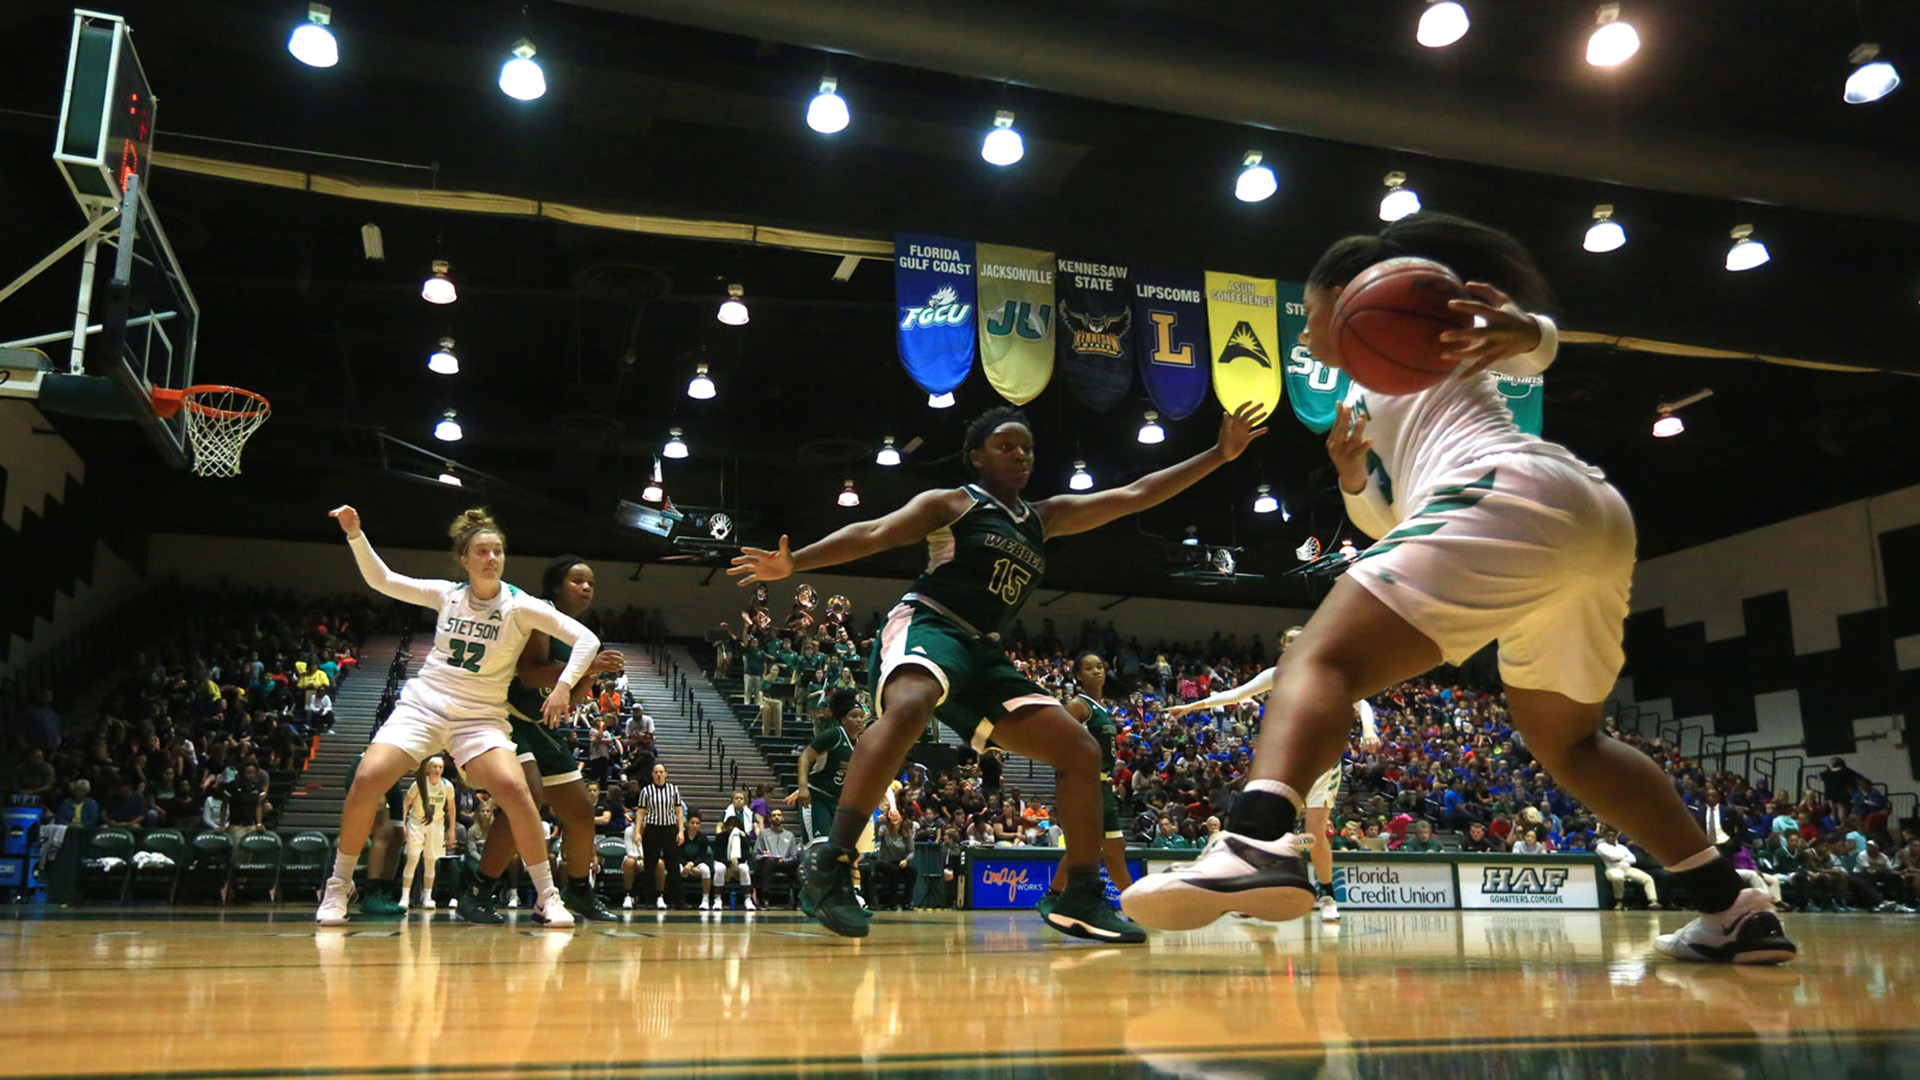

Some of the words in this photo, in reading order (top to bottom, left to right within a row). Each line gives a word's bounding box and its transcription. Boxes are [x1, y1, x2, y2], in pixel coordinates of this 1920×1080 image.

[910, 244, 961, 262] FLORIDA
[899, 256, 930, 271] GULF
[932, 259, 972, 275] COAST
[980, 263, 1053, 285] JACKSONVILLE
[1057, 258, 1128, 279] KENNESAW
[1074, 275, 1114, 292] STATE
[1228, 281, 1255, 293] ASUN
[1136, 284, 1201, 304] LIPSCOMB
[1210, 290, 1275, 308] CONFERENCE
[901, 304, 971, 330] FGCU
[986, 300, 1052, 339] JU
[1150, 310, 1195, 367] L
[988, 558, 1032, 605] 15
[445, 617, 500, 642] STETSON
[447, 638, 486, 673] 32
[982, 864, 1030, 902] image
[1347, 866, 1399, 884] Florida
[1481, 866, 1569, 894] HAF
[1016, 883, 1044, 892] WORKS
[1348, 886, 1397, 904] Credit
[1399, 886, 1446, 904] Union
[1489, 895, 1564, 905] GOHATTERS.COM/GIVE
